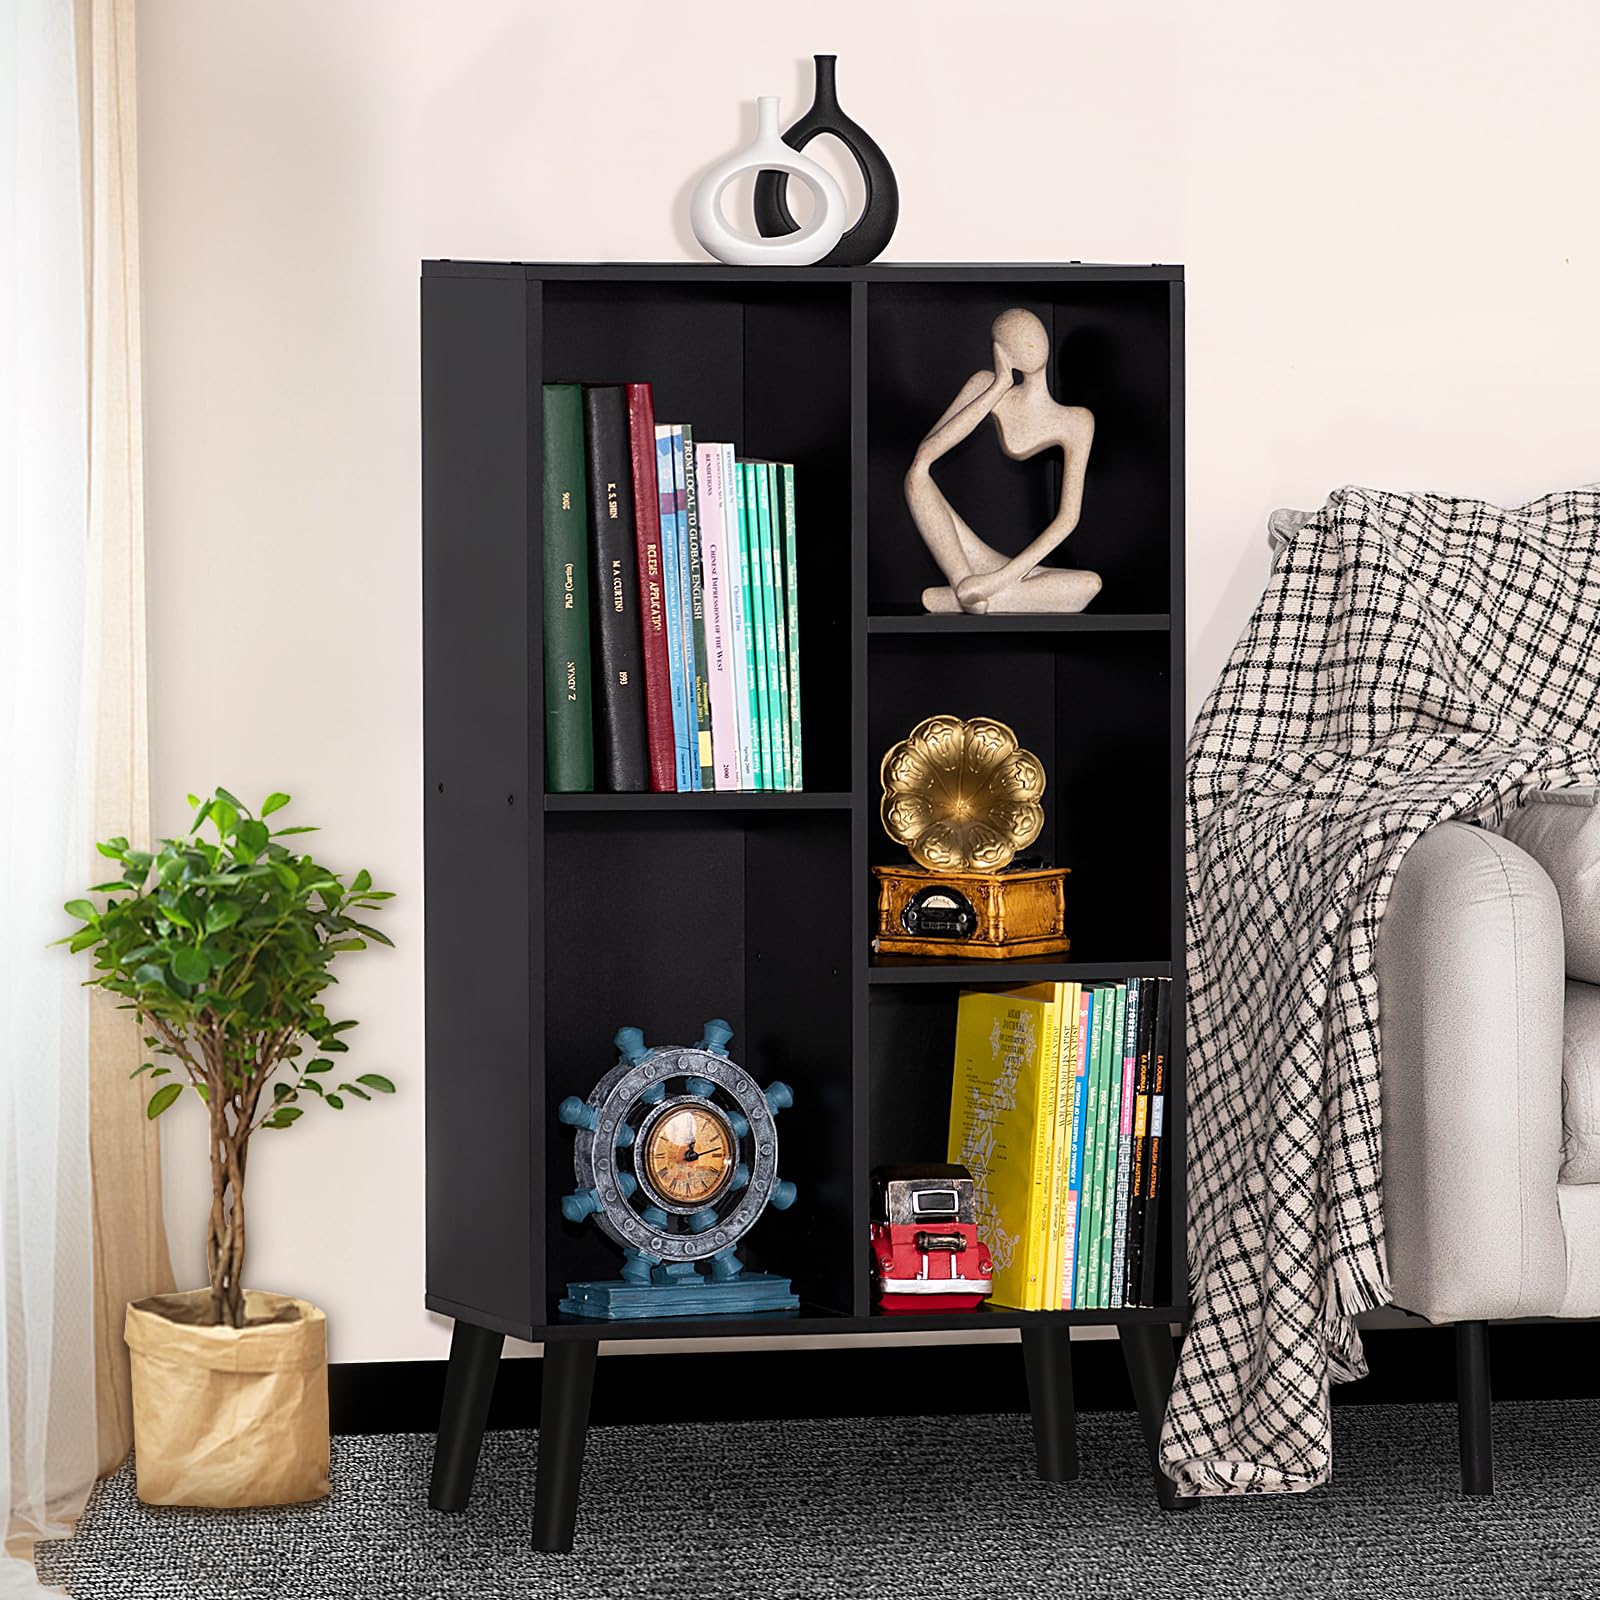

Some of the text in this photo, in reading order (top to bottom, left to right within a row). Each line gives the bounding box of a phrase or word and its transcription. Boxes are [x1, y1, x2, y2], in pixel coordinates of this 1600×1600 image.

[684, 440, 702, 620] FROM LOCAL TO GLOBAL ENGLISH
[710, 544, 718, 575] CHINESE
[564, 563, 574, 609] PhD (Curtin)
[613, 577, 624, 611] (CURTIN)
[712, 577, 720, 623] IMPRESSIONS
[715, 625, 721, 635] OF
[567, 662, 576, 691] ADNAN
[1093, 1005, 1101, 1024] Asian
[1127, 1007, 1137, 1048] JOURNAL
[1091, 1025, 1100, 1059] Englishes
[1139, 1054, 1148, 1092] EA JOURNAL
[1155, 1055, 1164, 1093] EA JOURNAL
[1072, 1116, 1080, 1142] VARIETIES
[1074, 1107, 1080, 1115] OF
[1072, 1143, 1078, 1152] OF
[1133, 1136, 1143, 1197] ENGLISH AUSTRALIA
[1149, 1137, 1159, 1199] ENGLISH AUSTRALIA
[1062, 1201, 1077, 1299] ENGLISH WORLD-WIDE
